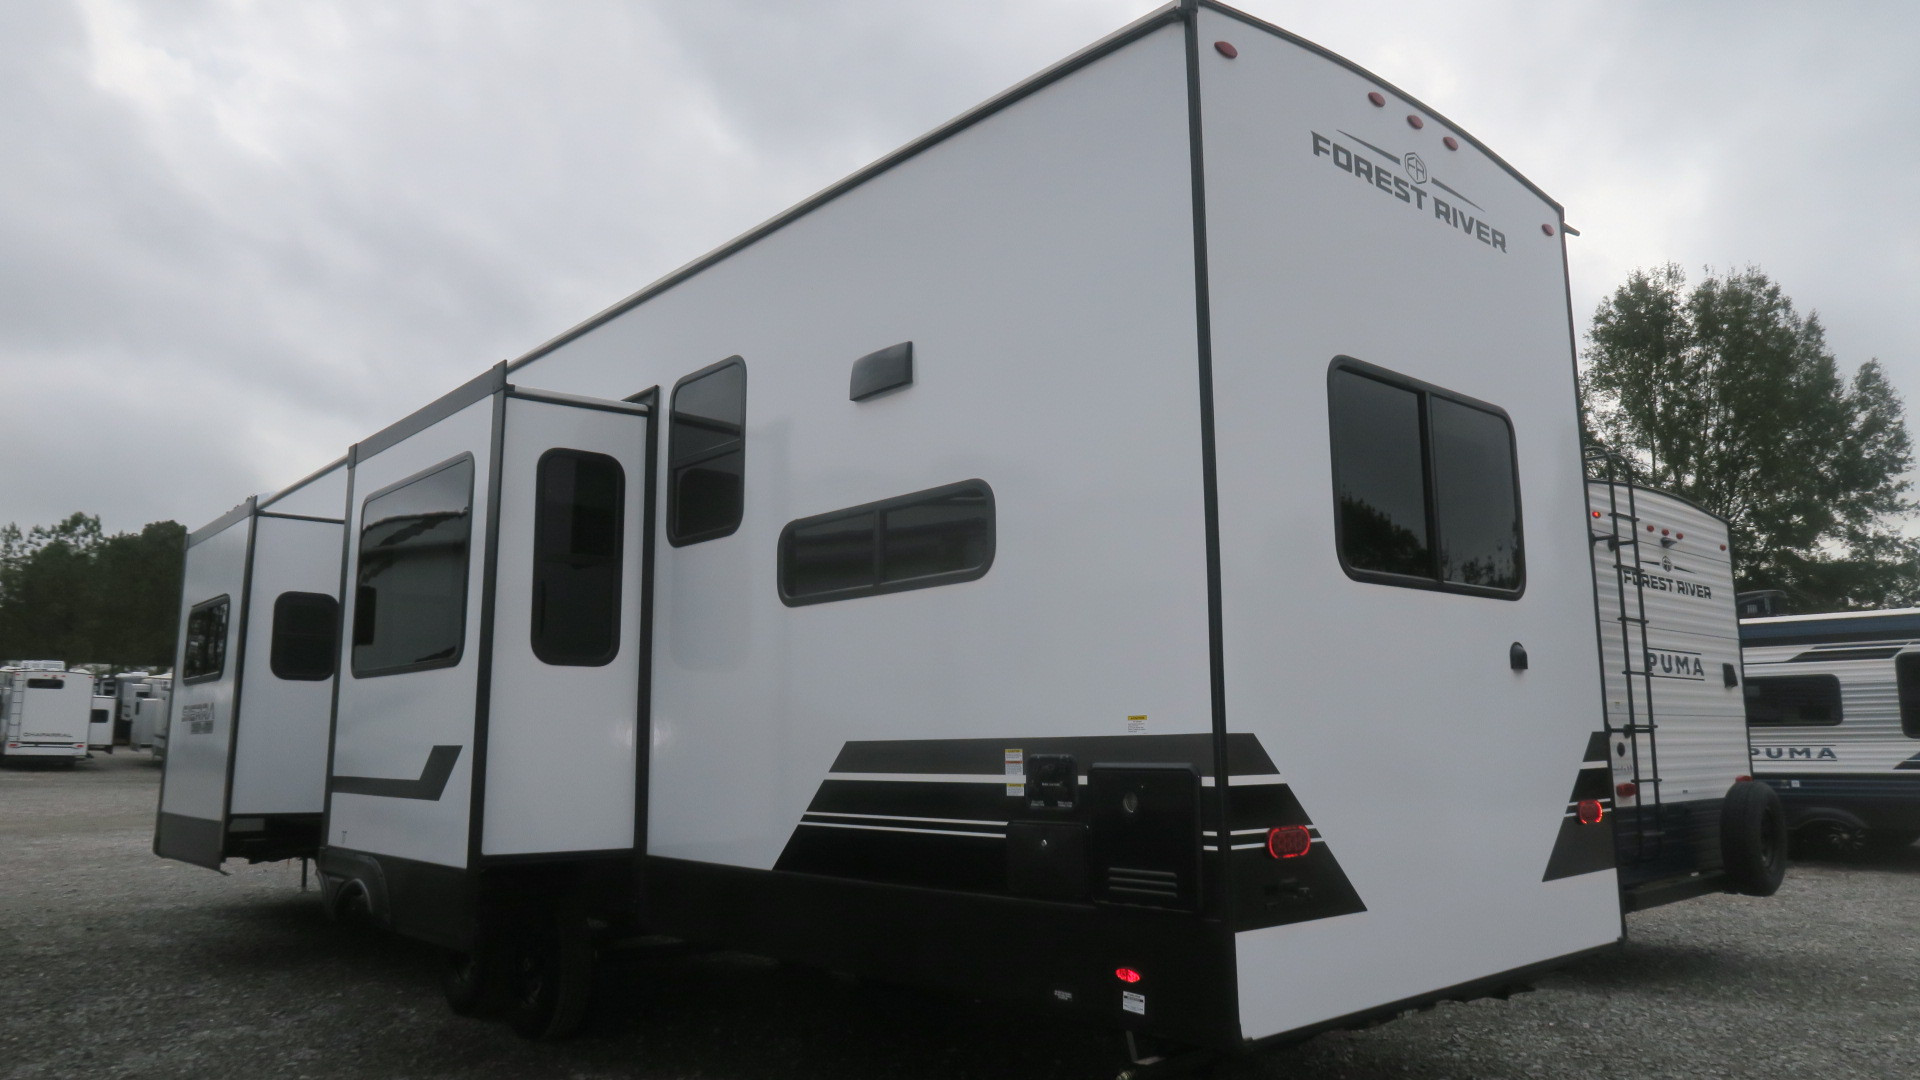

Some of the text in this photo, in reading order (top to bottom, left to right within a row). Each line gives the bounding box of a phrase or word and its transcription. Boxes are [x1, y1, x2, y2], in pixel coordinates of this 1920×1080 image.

[1310, 130, 1507, 254] FOREST RIVER
[1676, 580, 1711, 599] RIVER
[1647, 652, 1704, 676] PUMA
